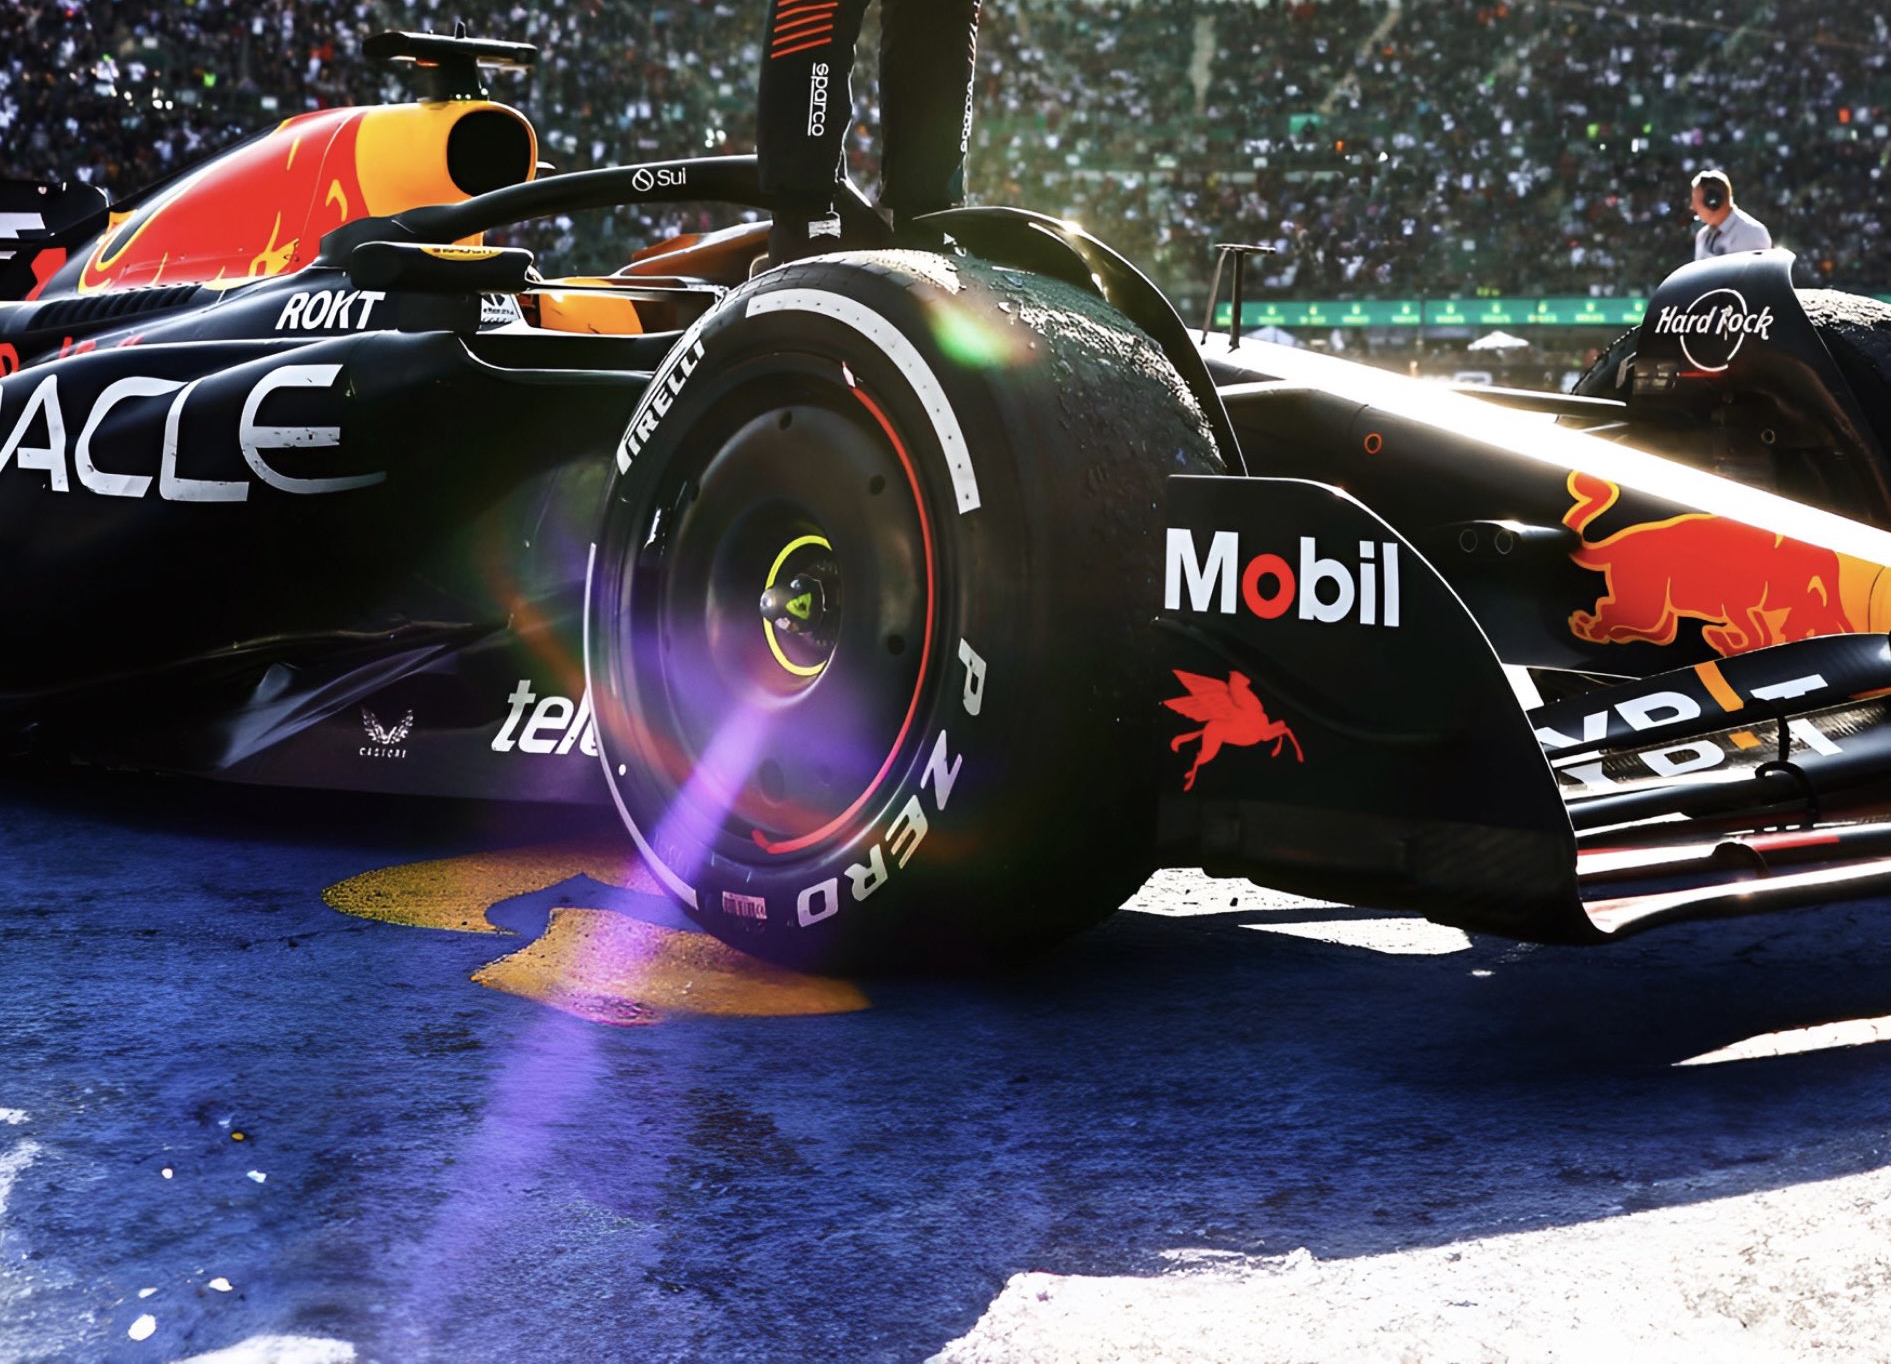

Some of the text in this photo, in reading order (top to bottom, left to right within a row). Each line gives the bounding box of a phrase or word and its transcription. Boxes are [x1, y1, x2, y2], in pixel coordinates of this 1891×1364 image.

[807, 63, 829, 137] sparco
[657, 167, 686, 186] Sui
[275, 291, 386, 331] ROKT
[1655, 304, 1774, 340] Hard Rock
[0, 364, 387, 502] ACLE
[616, 329, 706, 476] PIRELLI
[1164, 527, 1400, 627] Mobil
[796, 637, 987, 927] P ZERO
